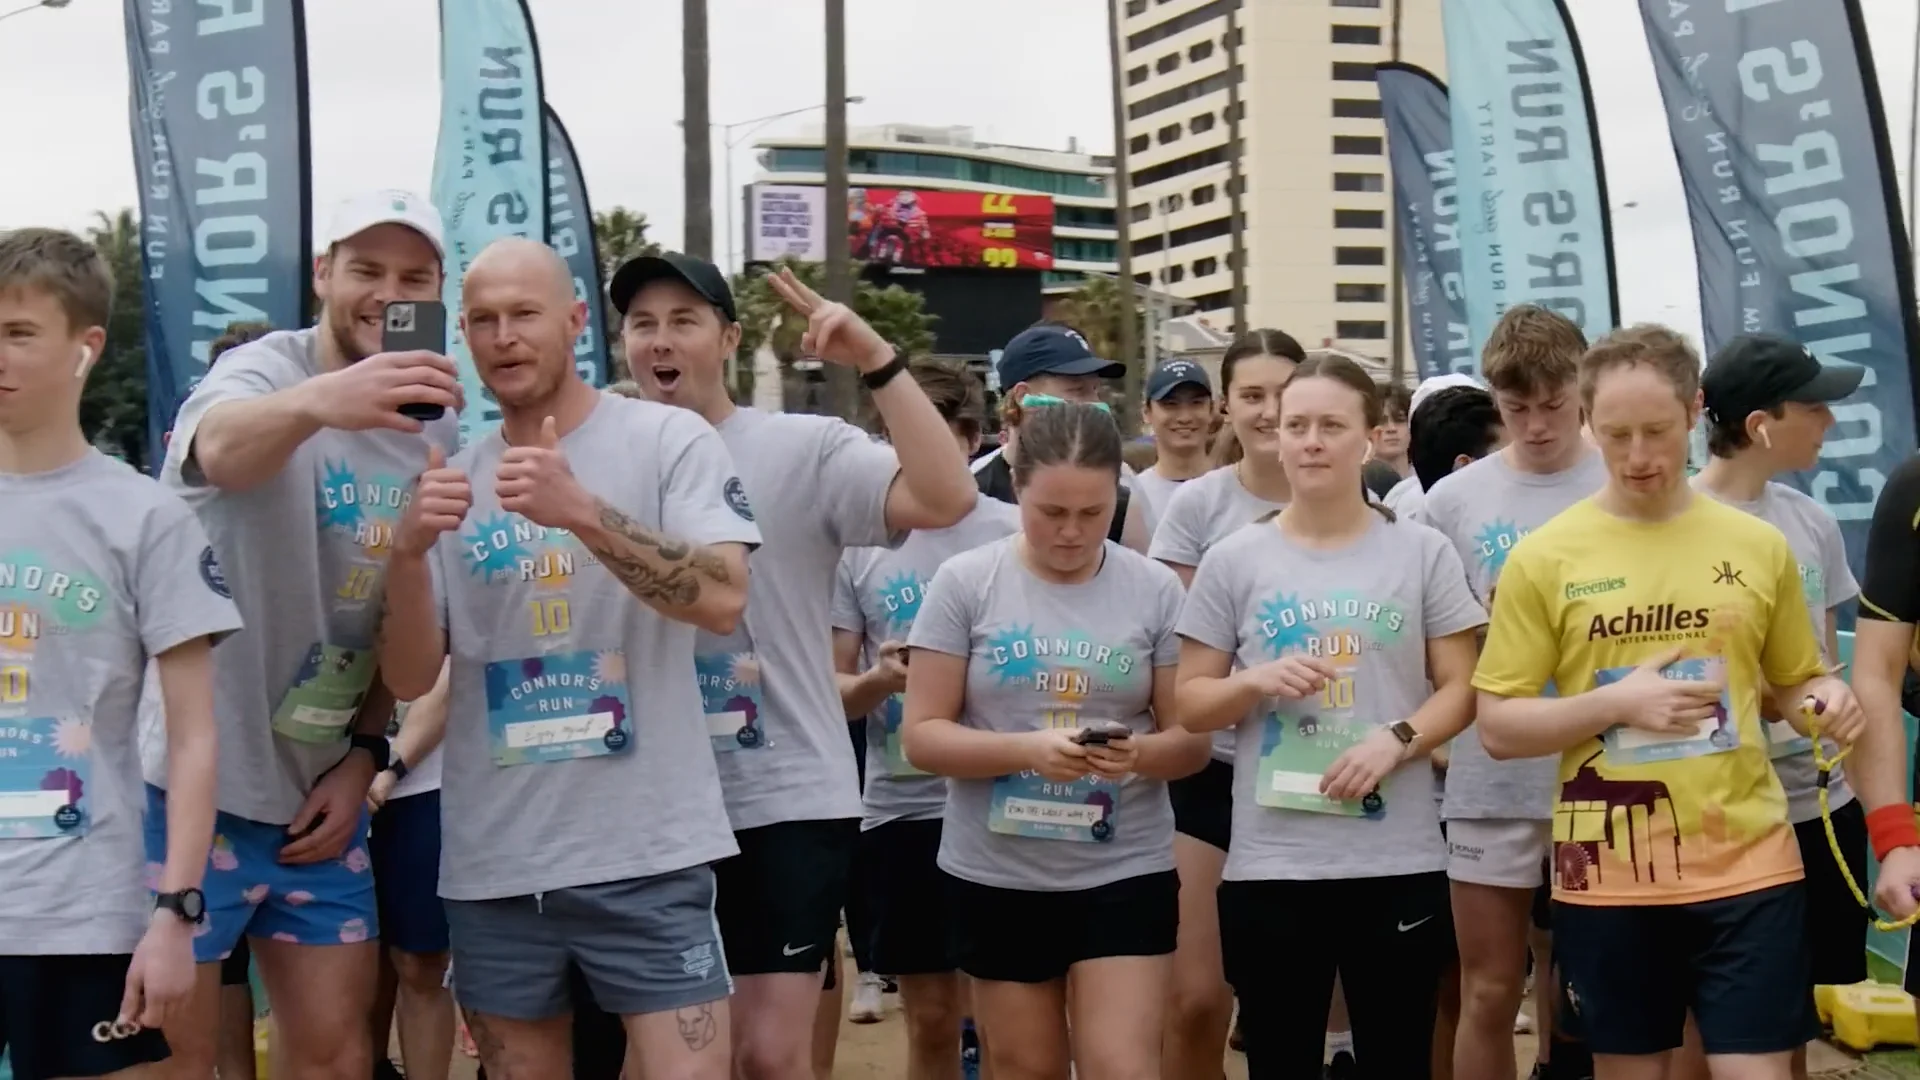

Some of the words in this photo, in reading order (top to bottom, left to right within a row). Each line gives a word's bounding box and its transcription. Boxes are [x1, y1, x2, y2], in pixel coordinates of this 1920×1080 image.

[519, 552, 574, 583] RUN
[0, 562, 103, 614] NOR'S
[1565, 576, 1627, 600] Greenies
[0, 610, 39, 639] UN
[528, 599, 571, 637] 10
[1262, 599, 1403, 640] CONNOR'S
[1588, 603, 1711, 642] Achilles
[1308, 634, 1362, 658] RUN
[1615, 630, 1708, 647] INTERNATIONAL
[992, 637, 1134, 675] CONNOR'S
[511, 672, 601, 700] CONNOR'S
[1035, 671, 1090, 695] RUN
[1323, 677, 1354, 710] 10
[539, 696, 573, 713] RUN
[1042, 783, 1074, 797] RUN
